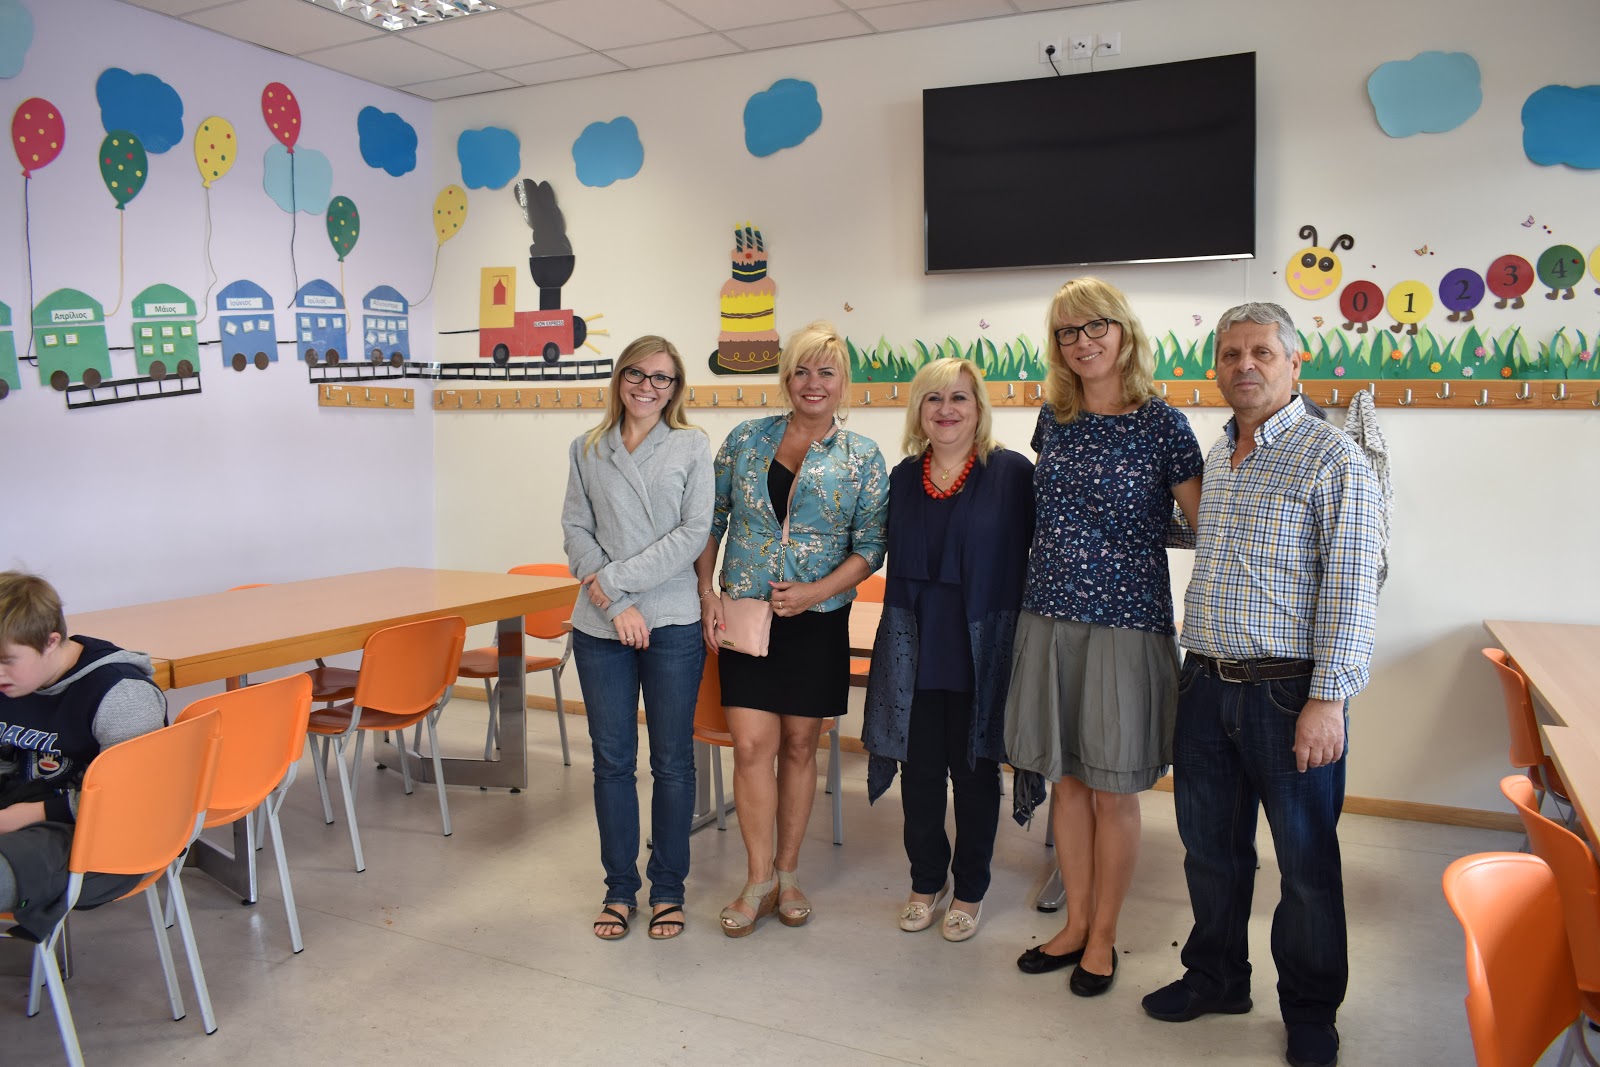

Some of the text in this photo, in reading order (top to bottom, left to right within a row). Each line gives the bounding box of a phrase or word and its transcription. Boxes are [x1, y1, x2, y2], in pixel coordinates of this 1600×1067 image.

[1352, 257, 1568, 313] 0 1 2 3 4
[154, 305, 177, 314] Μάιος
[54, 311, 88, 321] Απρίλιος
